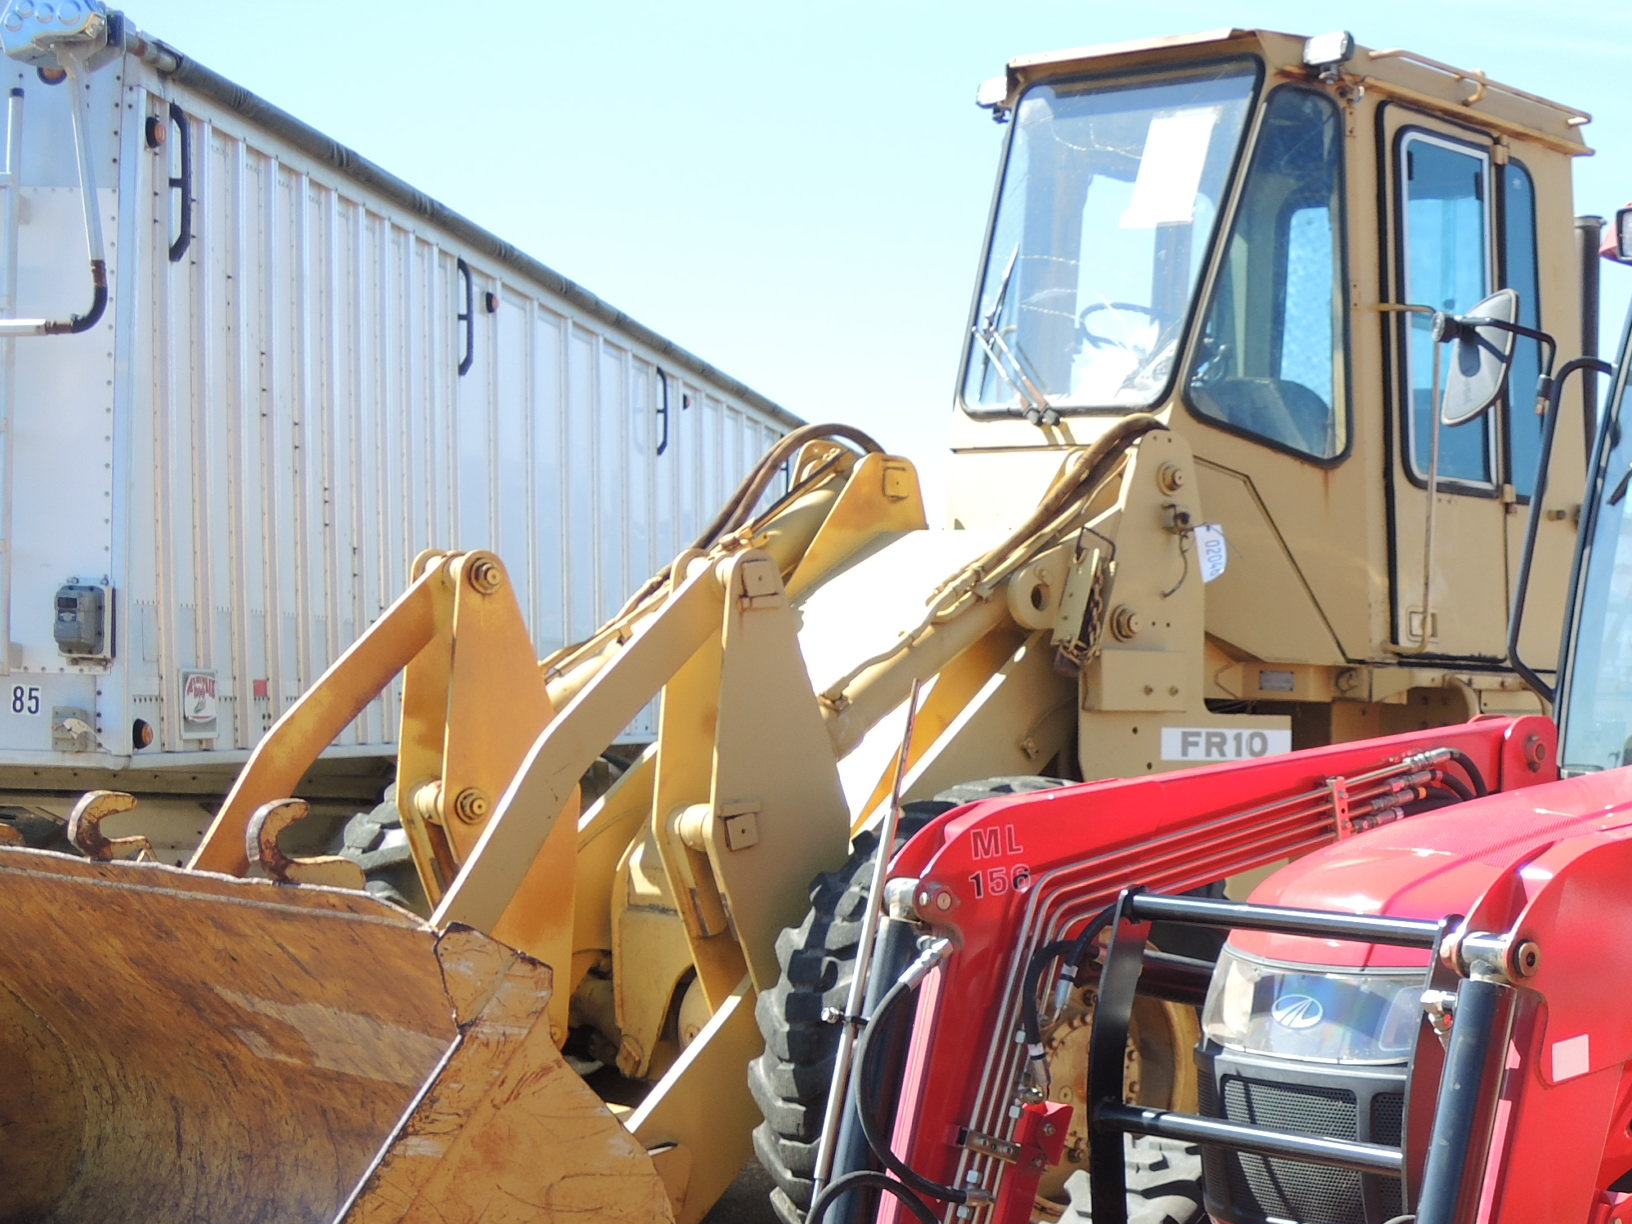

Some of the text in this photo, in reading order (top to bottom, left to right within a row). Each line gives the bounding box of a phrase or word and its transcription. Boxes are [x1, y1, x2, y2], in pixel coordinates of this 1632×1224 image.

[12, 685, 40, 715] 85
[1180, 730, 1269, 758] FR10
[970, 824, 1024, 860] ML
[968, 863, 1031, 899] 156
